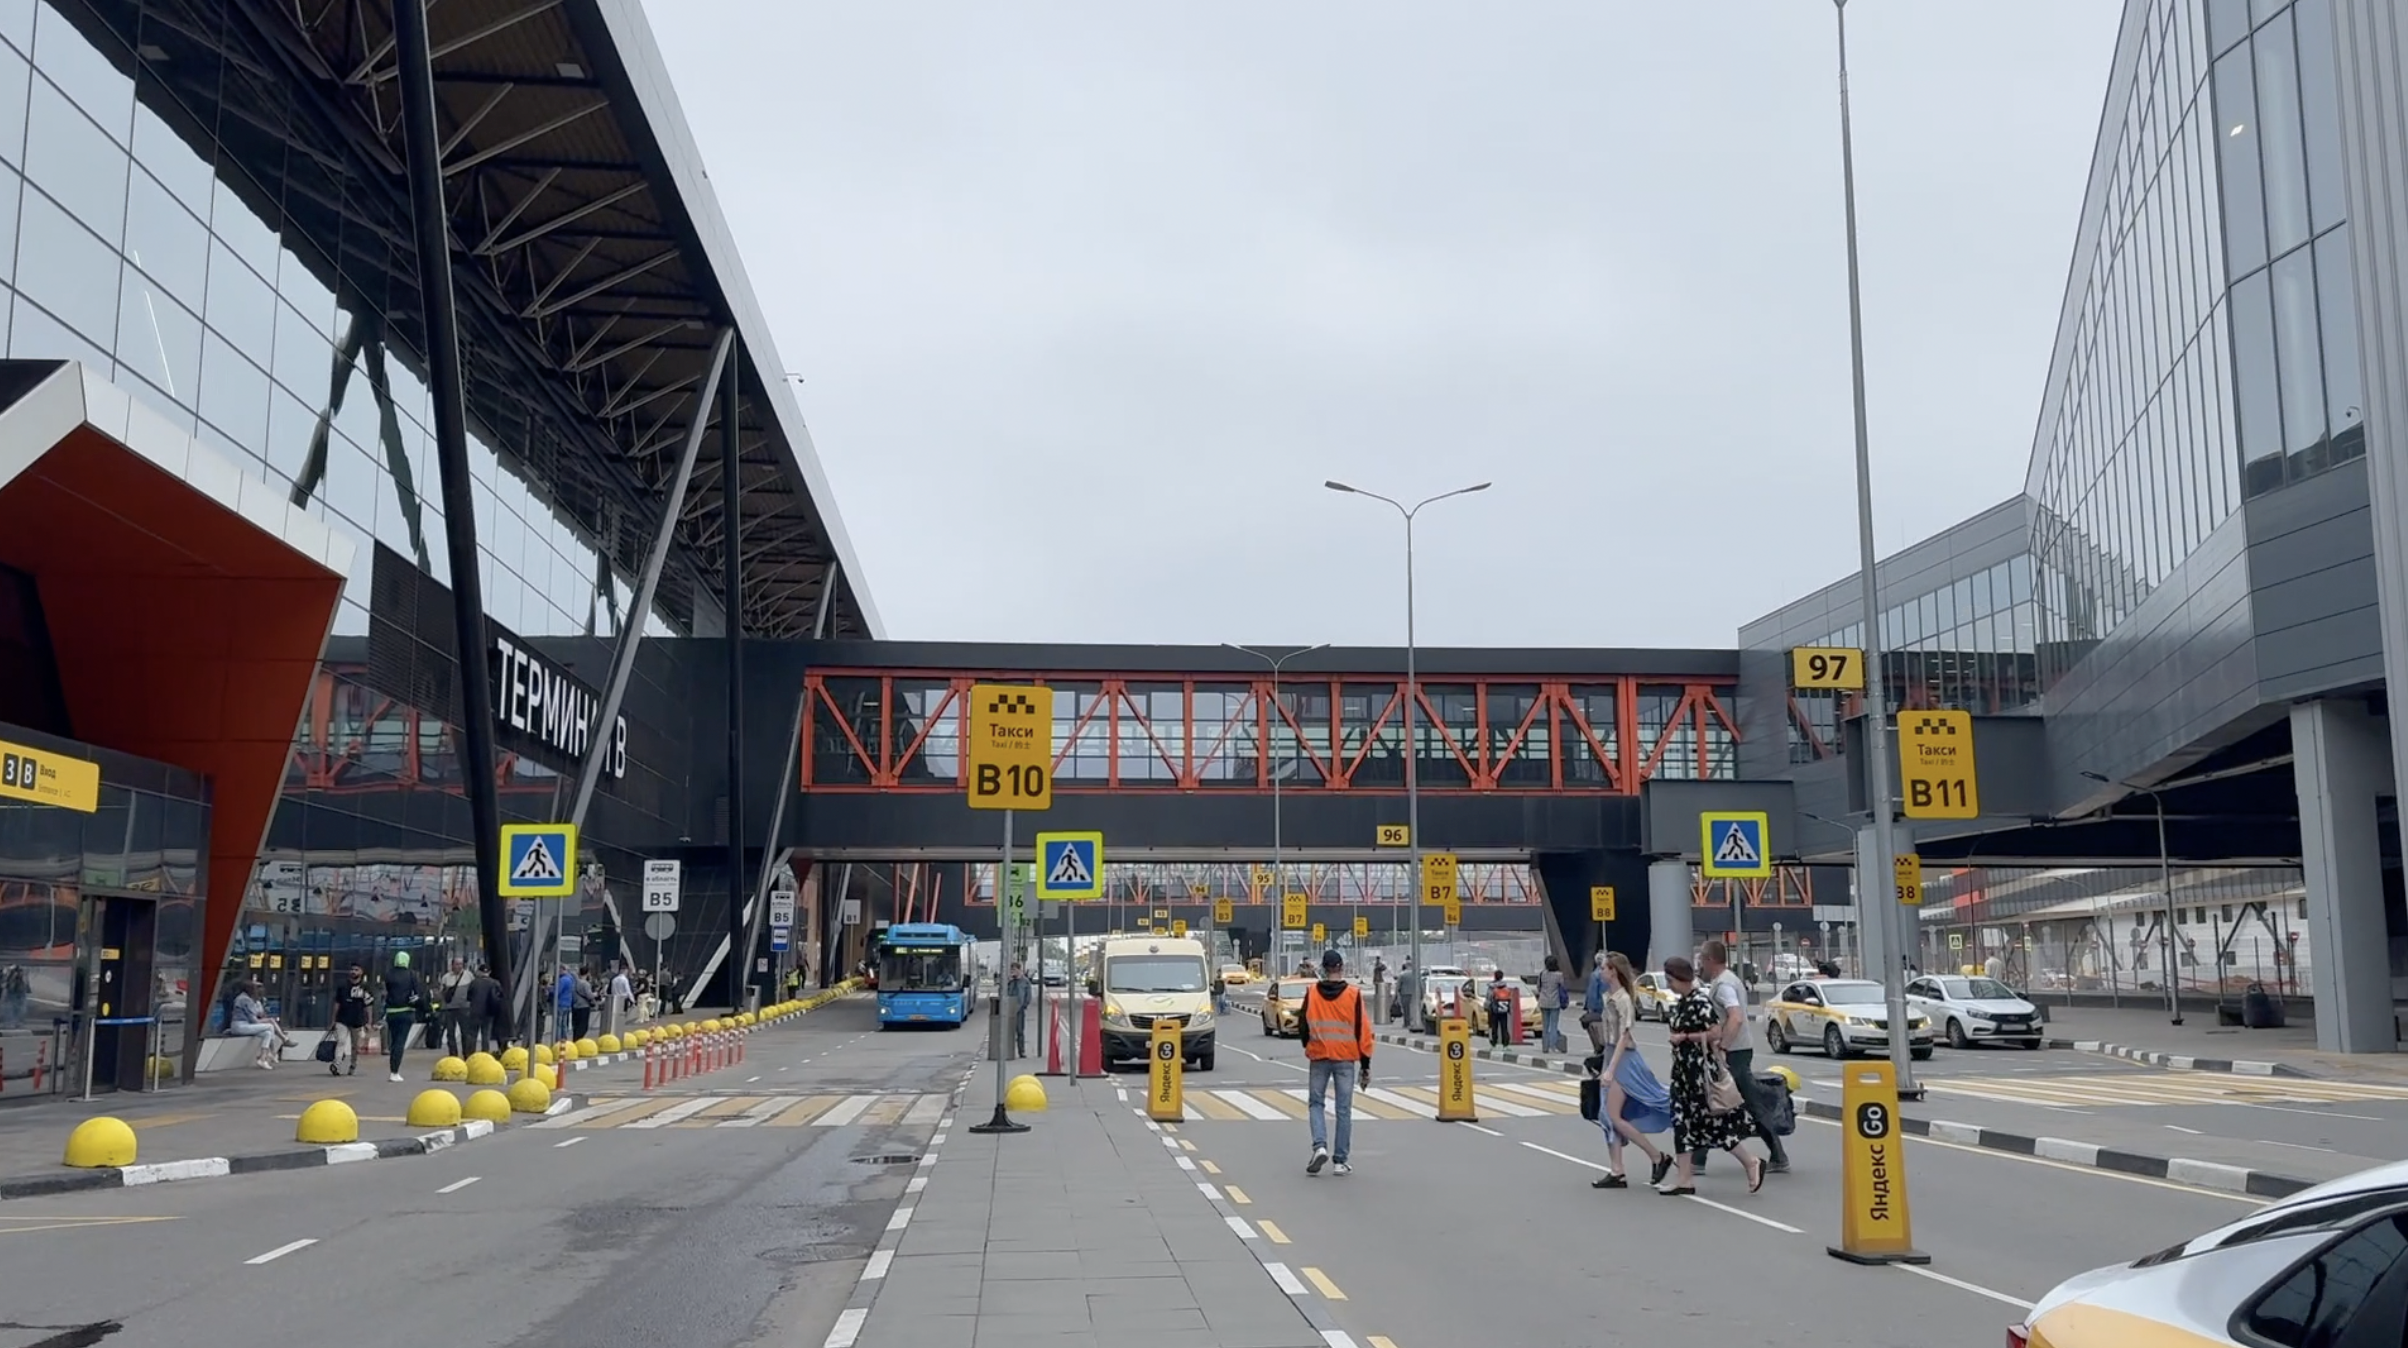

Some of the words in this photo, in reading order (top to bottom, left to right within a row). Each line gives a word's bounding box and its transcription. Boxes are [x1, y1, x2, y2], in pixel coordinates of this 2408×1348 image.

[1809, 654, 1847, 680] 97
[498, 637, 610, 773] ТЕРМИН
[989, 723, 1034, 738] Такси
[991, 740, 1007, 749] Taxi
[1917, 744, 1956, 756] Такси
[6, 759, 15, 780] 3
[24, 763, 33, 784] B
[977, 763, 1044, 797] B10
[1911, 779, 1967, 807] B11
[1383, 829, 1402, 842] 96
[1257, 873, 1270, 884] 95
[650, 892, 673, 906] B5
[1430, 886, 1451, 899] B7
[774, 912, 789, 922] B5
[1288, 914, 1302, 924] B7
[1597, 907, 1611, 917] B8
[1160, 1043, 1172, 1059] Go
[1450, 1043, 1462, 1059] Go
[1160, 1062, 1172, 1103] Яндекс
[1452, 1062, 1464, 1102] Яндекс
[1863, 1106, 1883, 1136] Go
[1870, 1144, 1890, 1221] Яндекс
